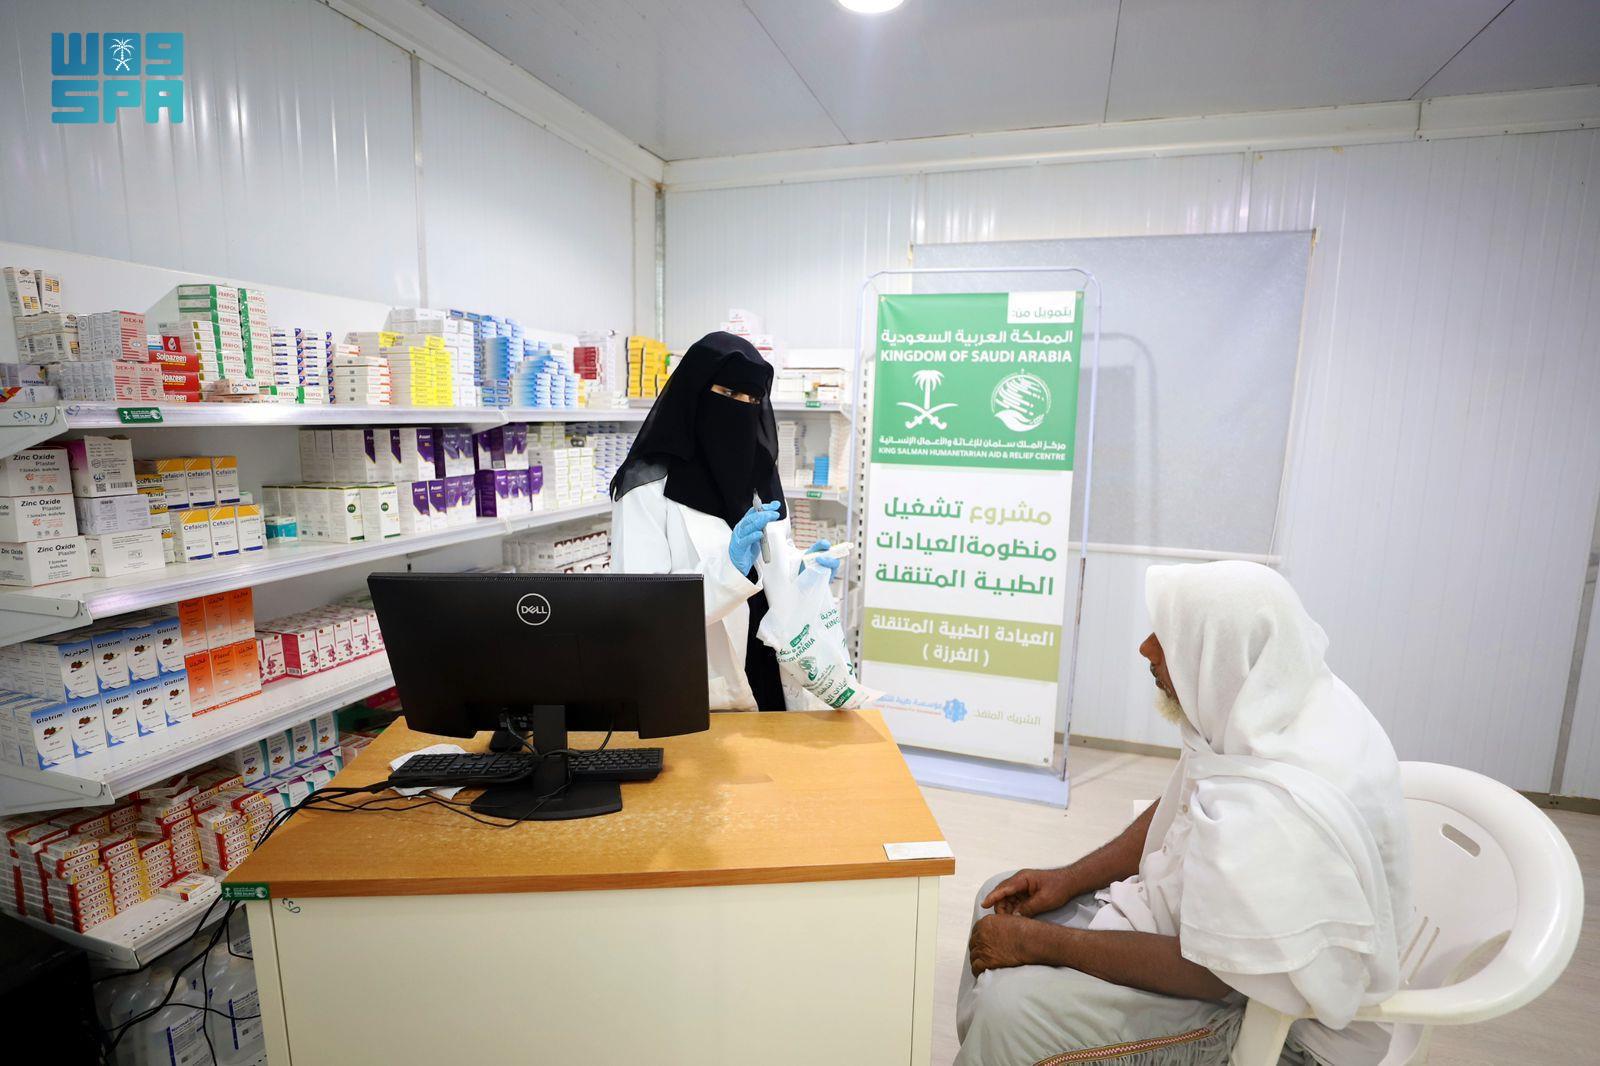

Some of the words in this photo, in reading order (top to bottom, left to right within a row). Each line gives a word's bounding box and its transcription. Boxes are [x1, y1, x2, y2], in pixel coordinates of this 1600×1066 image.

[1034, 304, 1072, 319] بتمويل
[881, 329, 952, 346] السعودية
[955, 329, 1007, 347] العربية
[1010, 329, 1073, 345] المملكة
[156, 353, 186, 362] Solpazeen
[880, 350, 948, 362] KINGDOM
[949, 350, 968, 362] OF
[971, 350, 1015, 363] SAUDI
[1018, 350, 1073, 363] ARABIA
[879, 434, 916, 446] الإنسانية
[916, 435, 952, 448] والأعمال
[952, 436, 982, 448] للإغاثة
[983, 438, 1015, 449] سلمان
[1017, 438, 1042, 450] الملك
[1043, 441, 1067, 452] مركز
[878, 447, 896, 455] KING
[897, 448, 928, 456] SALMAN
[929, 448, 987, 458] HUMANITARIAN
[988, 450, 1001, 459] AID
[1002, 451, 1008, 459] &
[1009, 451, 1034, 460] RELIEF
[1034, 452, 1066, 461] CENTRE
[884, 497, 964, 520] تشغيل
[969, 501, 1052, 528] مشروع
[55, 543, 76, 551] Oxide
[876, 531, 965, 556] العيادات
[966, 536, 1057, 562] منظومة
[875, 563, 965, 588] المتنقلة
[974, 571, 1054, 597] الطبية
[521, 605, 548, 614] DELL
[871, 614, 934, 634] المتنقلة
[939, 620, 990, 640] الطبية
[994, 626, 1055, 647] العيادة
[97, 640, 120, 649] Glotrim
[136, 686, 158, 695] Glotrim
[106, 695, 129, 704] Glotrim
[72, 703, 97, 714] Glotrim
[36, 712, 63, 725] Glotrim
[115, 843, 132, 852] AZOL
[74, 854, 95, 864] AZOL
[73, 864, 94, 874] AZOL
[86, 875, 106, 885] AZOL
[88, 883, 107, 893] AZOL
[125, 897, 143, 907] AZOL
[91, 907, 109, 918] AZOL
[93, 914, 111, 925] AZOL
